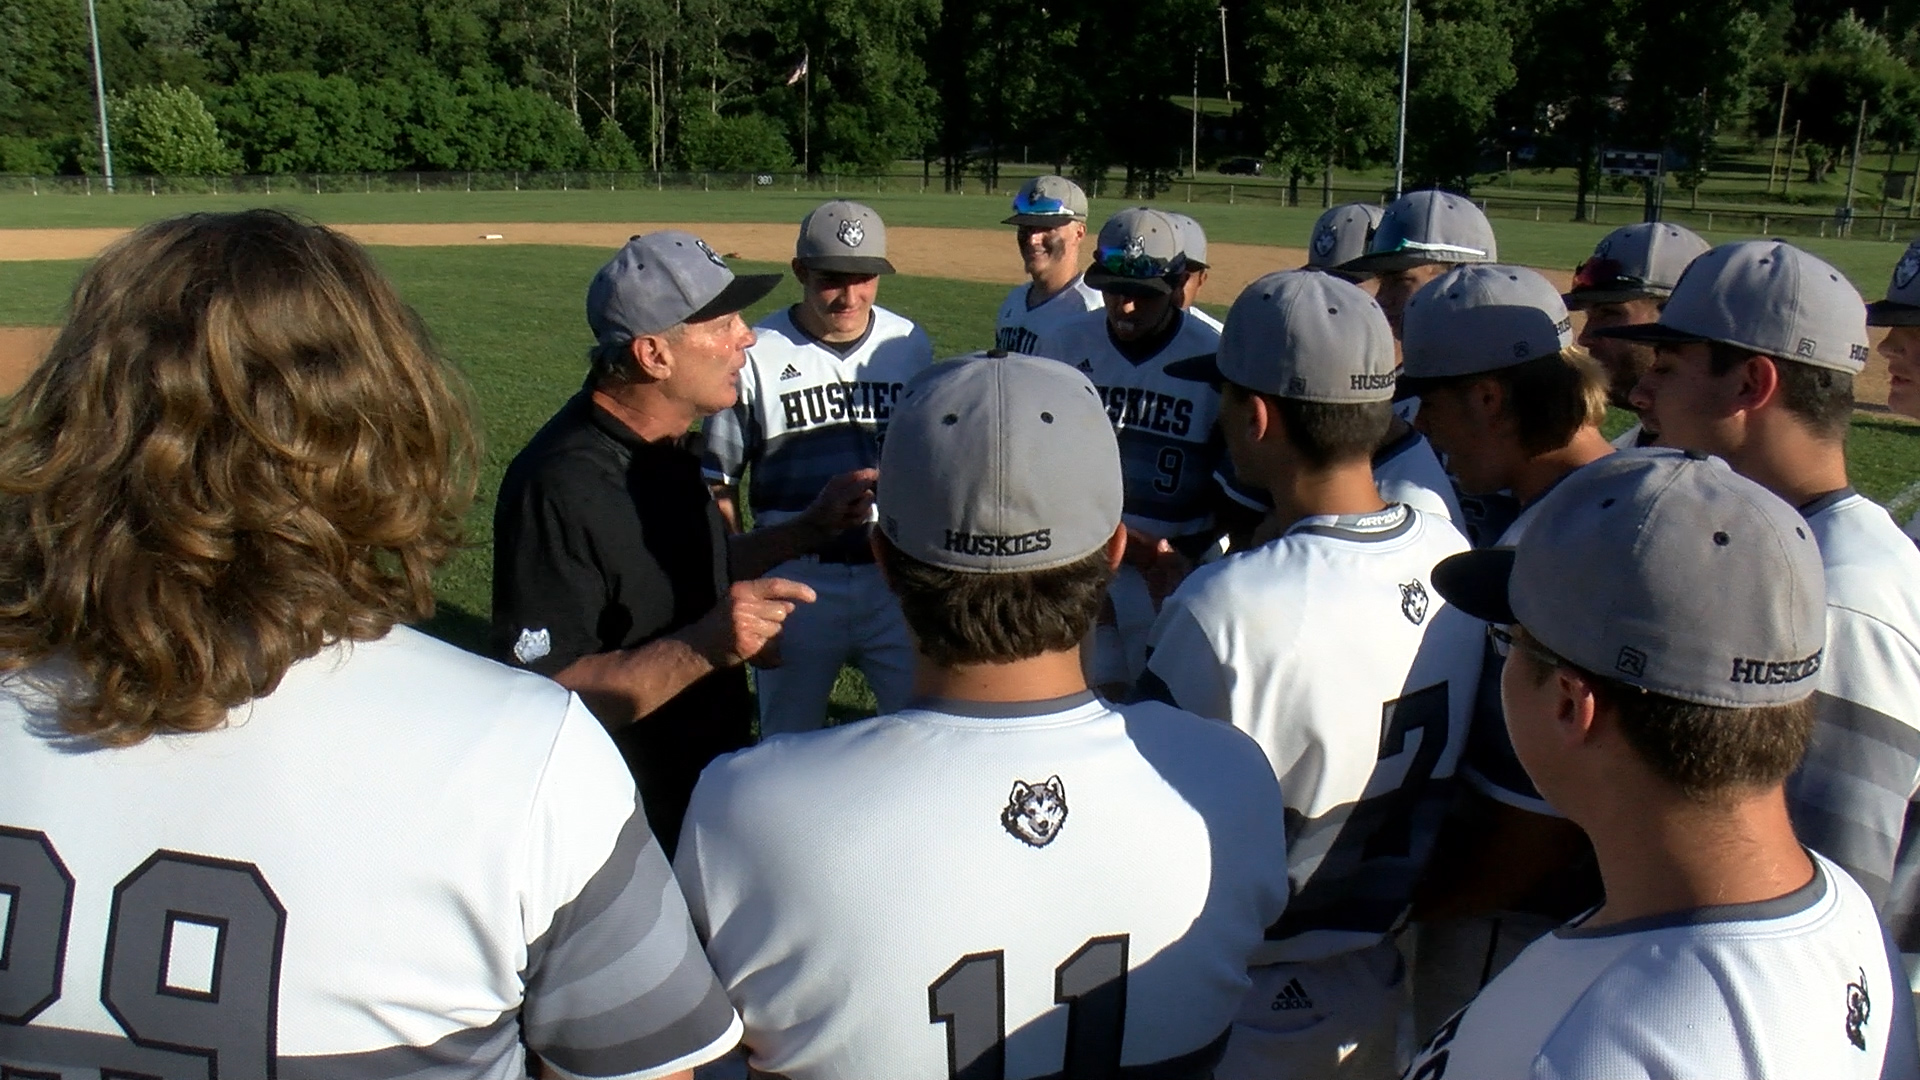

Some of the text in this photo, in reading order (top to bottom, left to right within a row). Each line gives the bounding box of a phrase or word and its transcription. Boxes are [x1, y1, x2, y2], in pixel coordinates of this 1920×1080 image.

[1154, 445, 1186, 497] 9
[1356, 506, 1405, 527] ARMOU
[944, 528, 1052, 556] HUSKIES
[1730, 647, 1823, 684] HUSKIE
[1361, 679, 1449, 863] 7
[928, 933, 1130, 1080] 11
